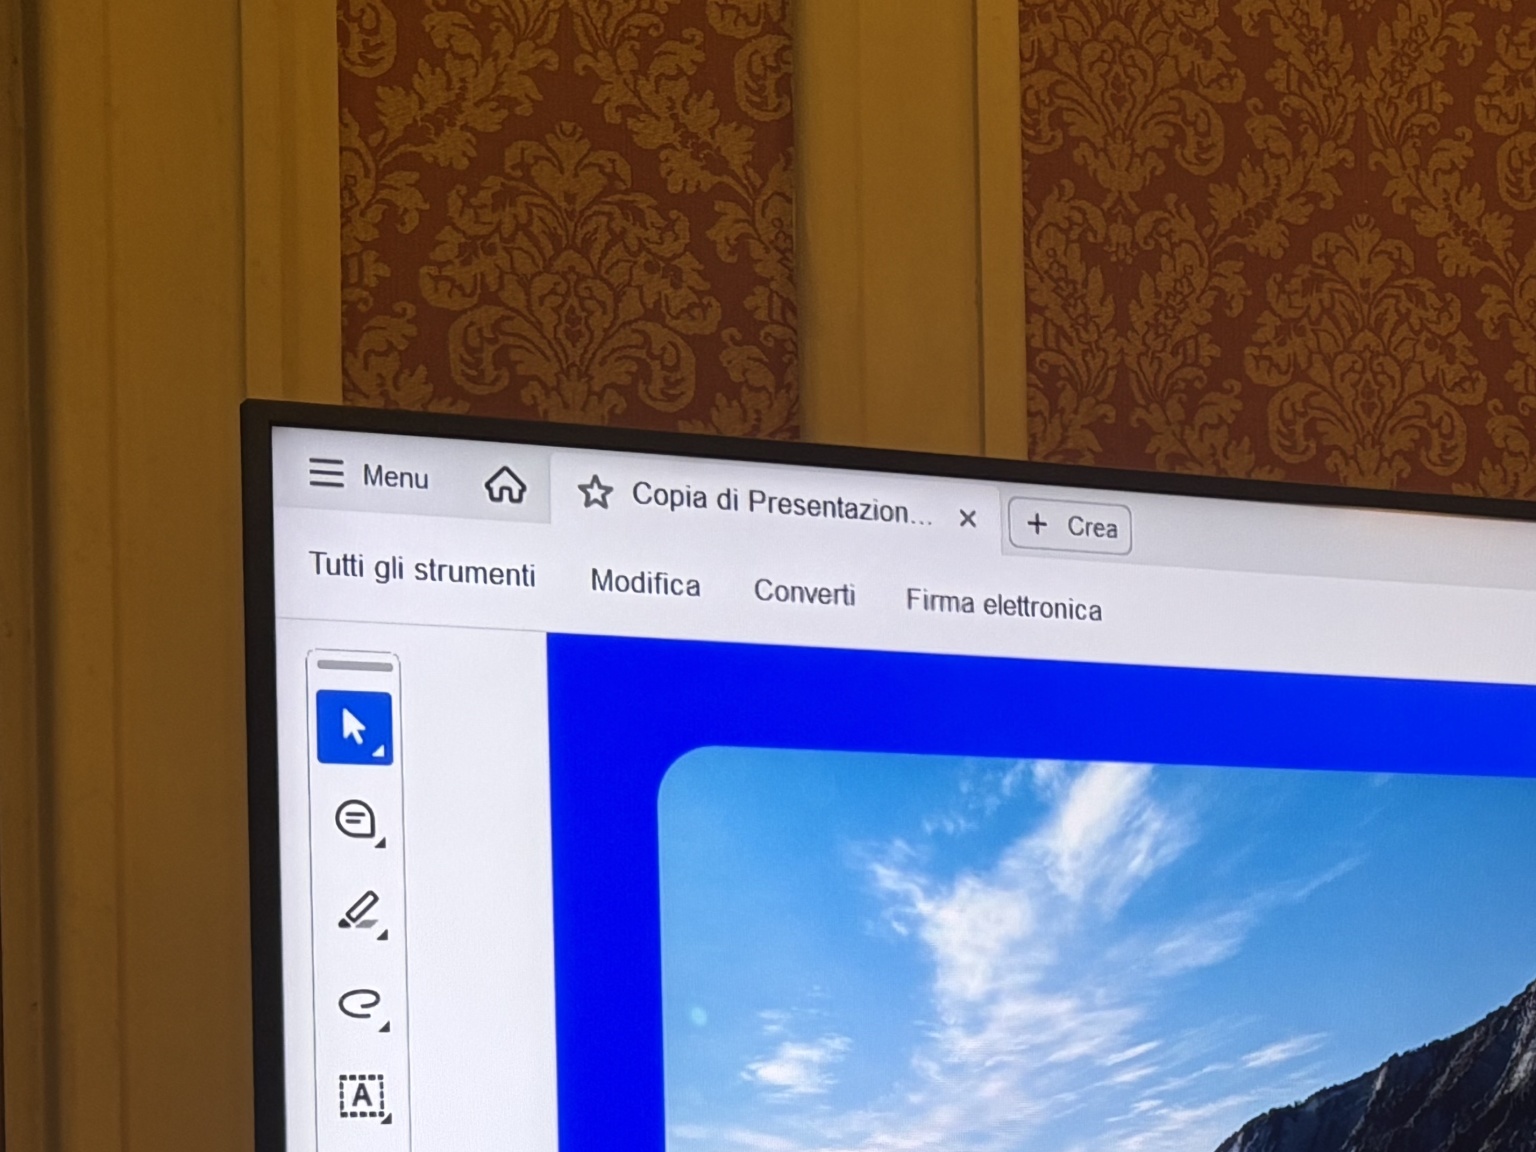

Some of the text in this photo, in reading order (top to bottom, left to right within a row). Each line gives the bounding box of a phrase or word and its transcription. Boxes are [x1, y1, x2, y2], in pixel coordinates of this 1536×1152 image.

[363, 463, 429, 490] Menu
[632, 481, 708, 512] Copia
[716, 487, 739, 512] di
[1067, 515, 1118, 539] Crea
[308, 550, 536, 588] Tutti gli strumenti
[591, 567, 701, 597] Modifica
[754, 578, 856, 606] Converti
[906, 587, 1103, 622] Firma elettronica
